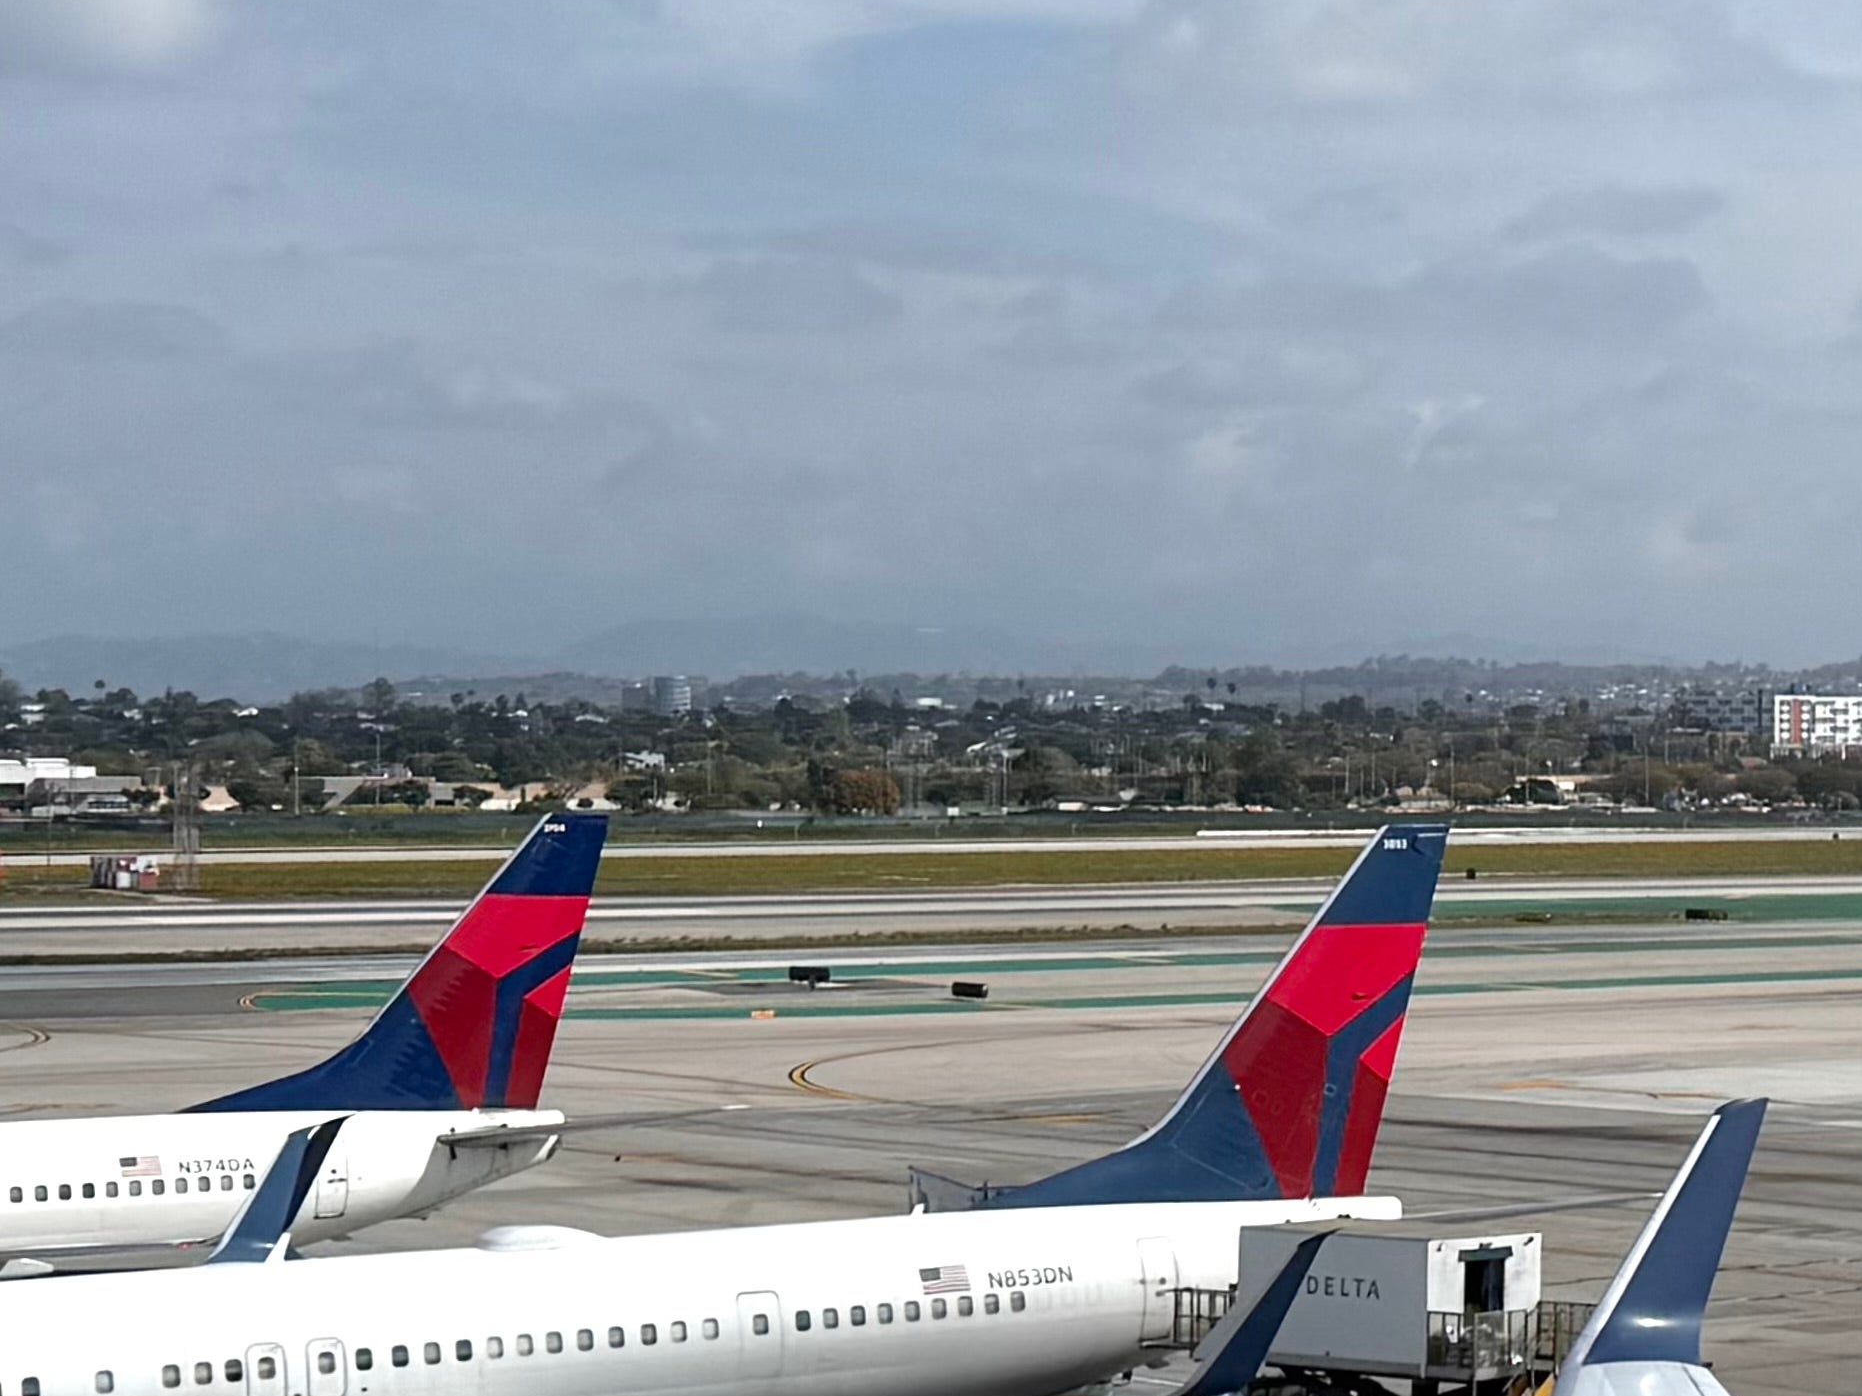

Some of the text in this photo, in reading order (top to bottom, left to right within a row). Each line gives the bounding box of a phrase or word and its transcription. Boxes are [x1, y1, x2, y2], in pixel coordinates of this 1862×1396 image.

[179, 1158, 255, 1173] N374DA
[988, 1266, 1073, 1289] N853DN
[1307, 1275, 1380, 1300] DELTA
